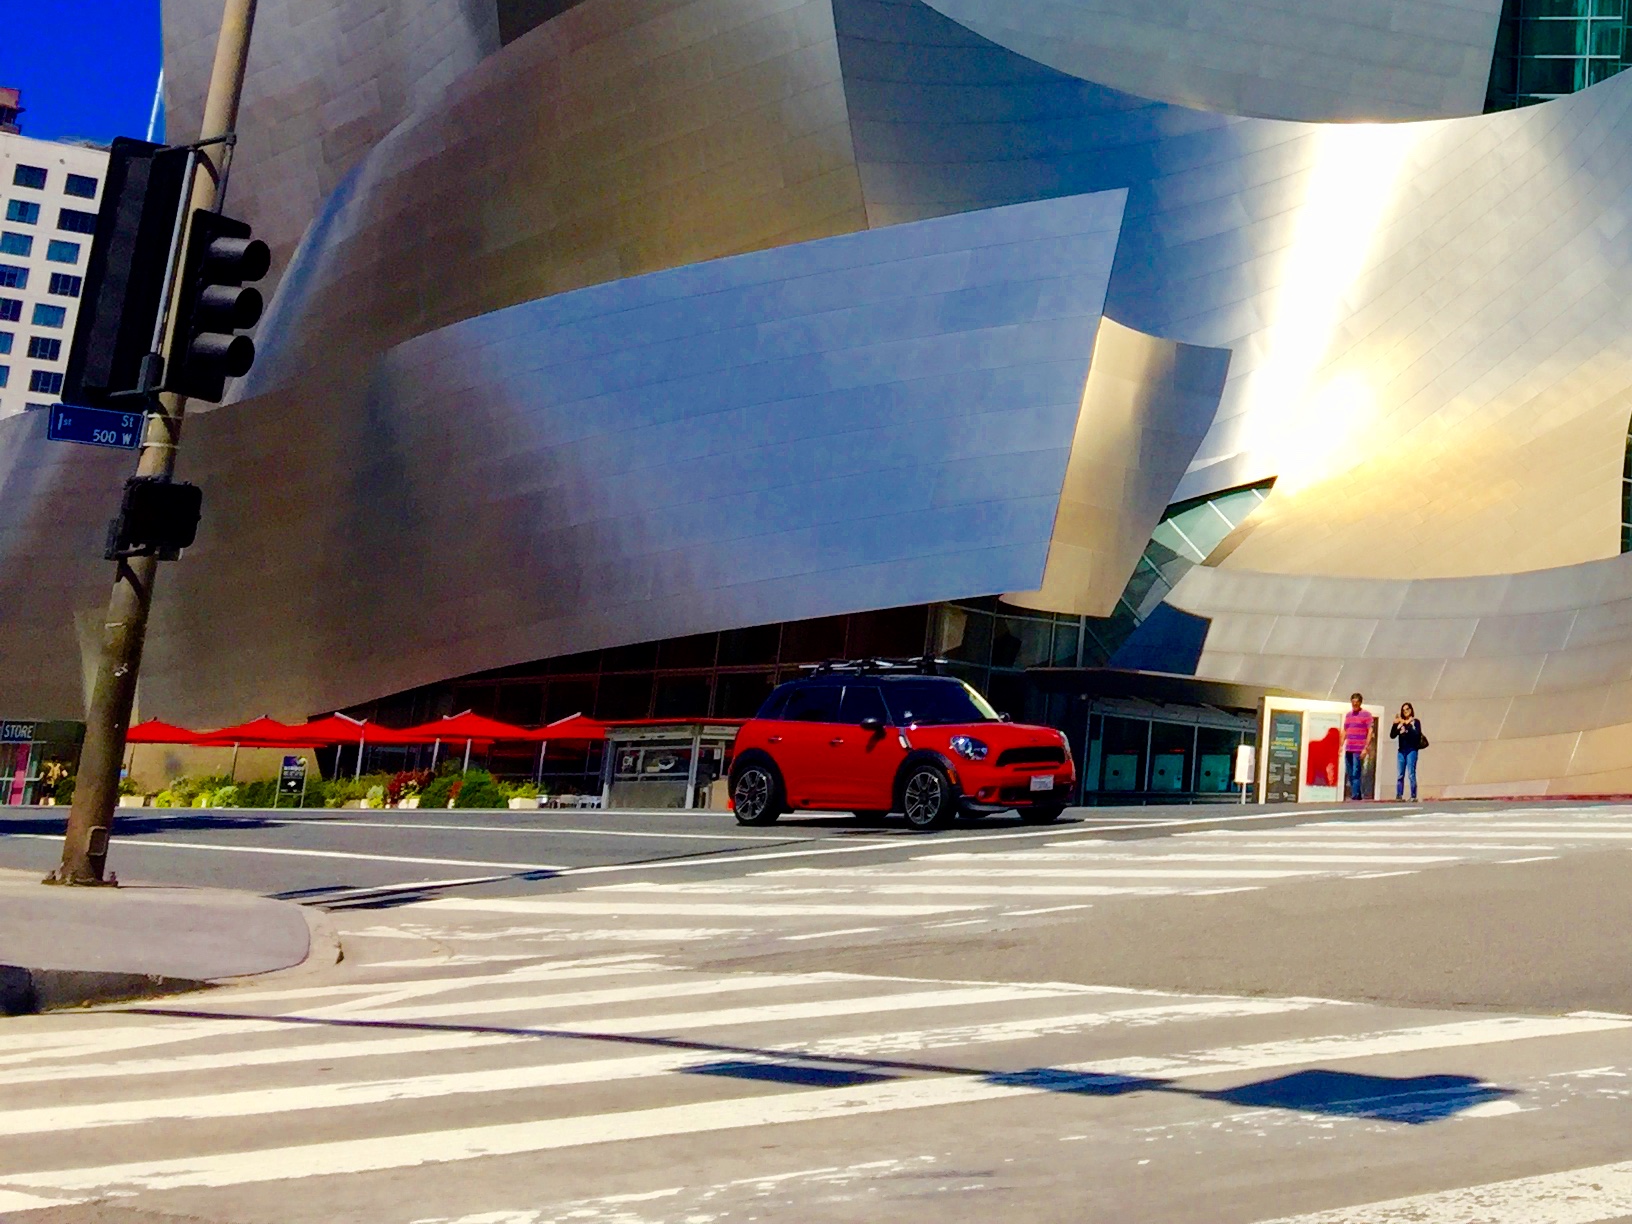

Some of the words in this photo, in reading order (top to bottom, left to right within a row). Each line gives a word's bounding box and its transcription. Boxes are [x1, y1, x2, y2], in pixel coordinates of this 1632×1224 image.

[57, 412, 73, 431] 1st
[121, 414, 135, 428] St
[92, 429, 117, 444] 500
[122, 432, 133, 445] W
[4, 724, 33, 738] STORE
